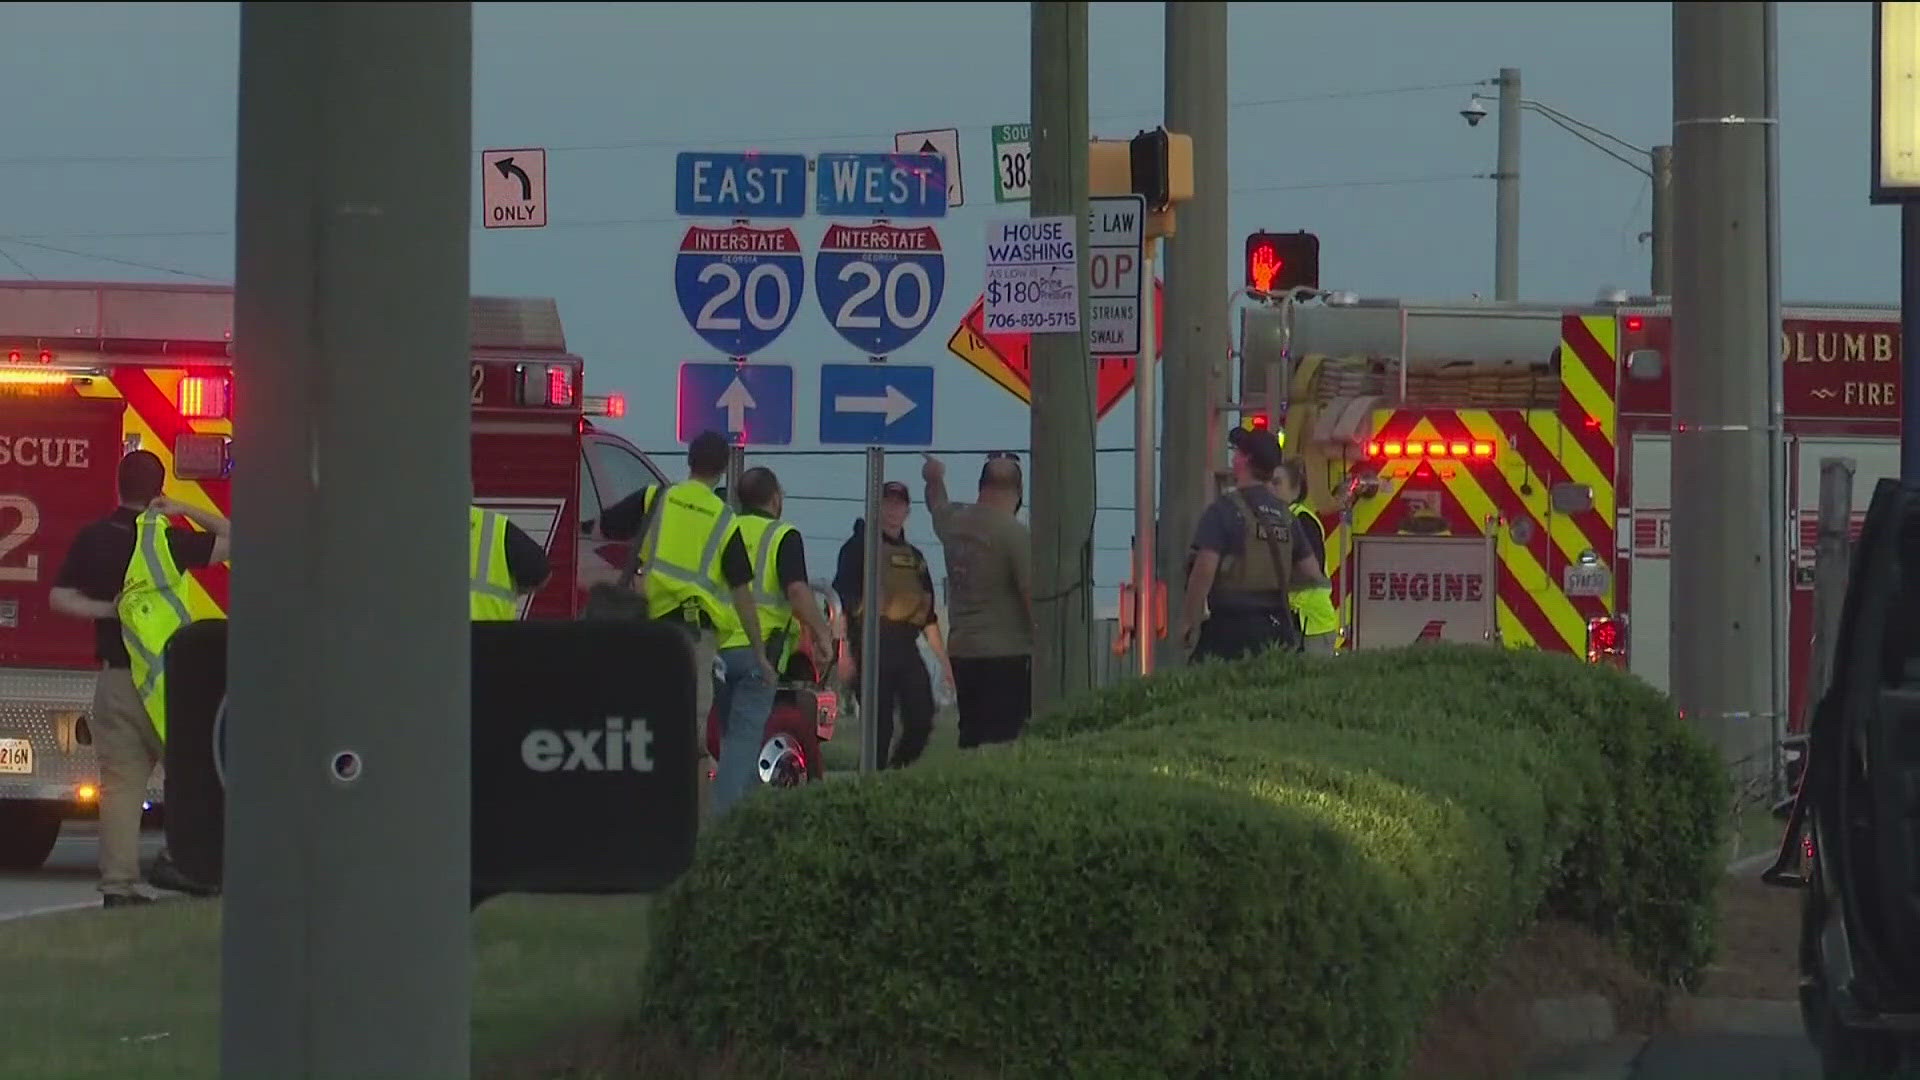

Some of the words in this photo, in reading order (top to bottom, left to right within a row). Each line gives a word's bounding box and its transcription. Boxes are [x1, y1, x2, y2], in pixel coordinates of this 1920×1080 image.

[694, 161, 788, 204] EAST
[833, 161, 931, 204] WEST
[494, 206, 535, 220] ONLY
[1103, 213, 1134, 232] LAW
[695, 233, 785, 250] INTERSTATE
[836, 231, 926, 248] INTERSTATE
[1003, 223, 1063, 242] HOUSE
[721, 254, 758, 263] GEORGIA
[861, 252, 899, 262] GEORGIA
[989, 242, 1074, 261] WASHING
[1090, 254, 1133, 290] OP
[696, 262, 790, 331] 20
[836, 261, 931, 329] 20
[987, 279, 1041, 308] $180
[988, 312, 1077, 328] 706-830-5715
[1782, 331, 1902, 362] LUMB
[471, 364, 484, 404] 2
[1844, 382, 1896, 405] FIRE
[0, 494, 40, 582] 2
[1368, 572, 1483, 602] ENGINE
[521, 716, 653, 772] exit
